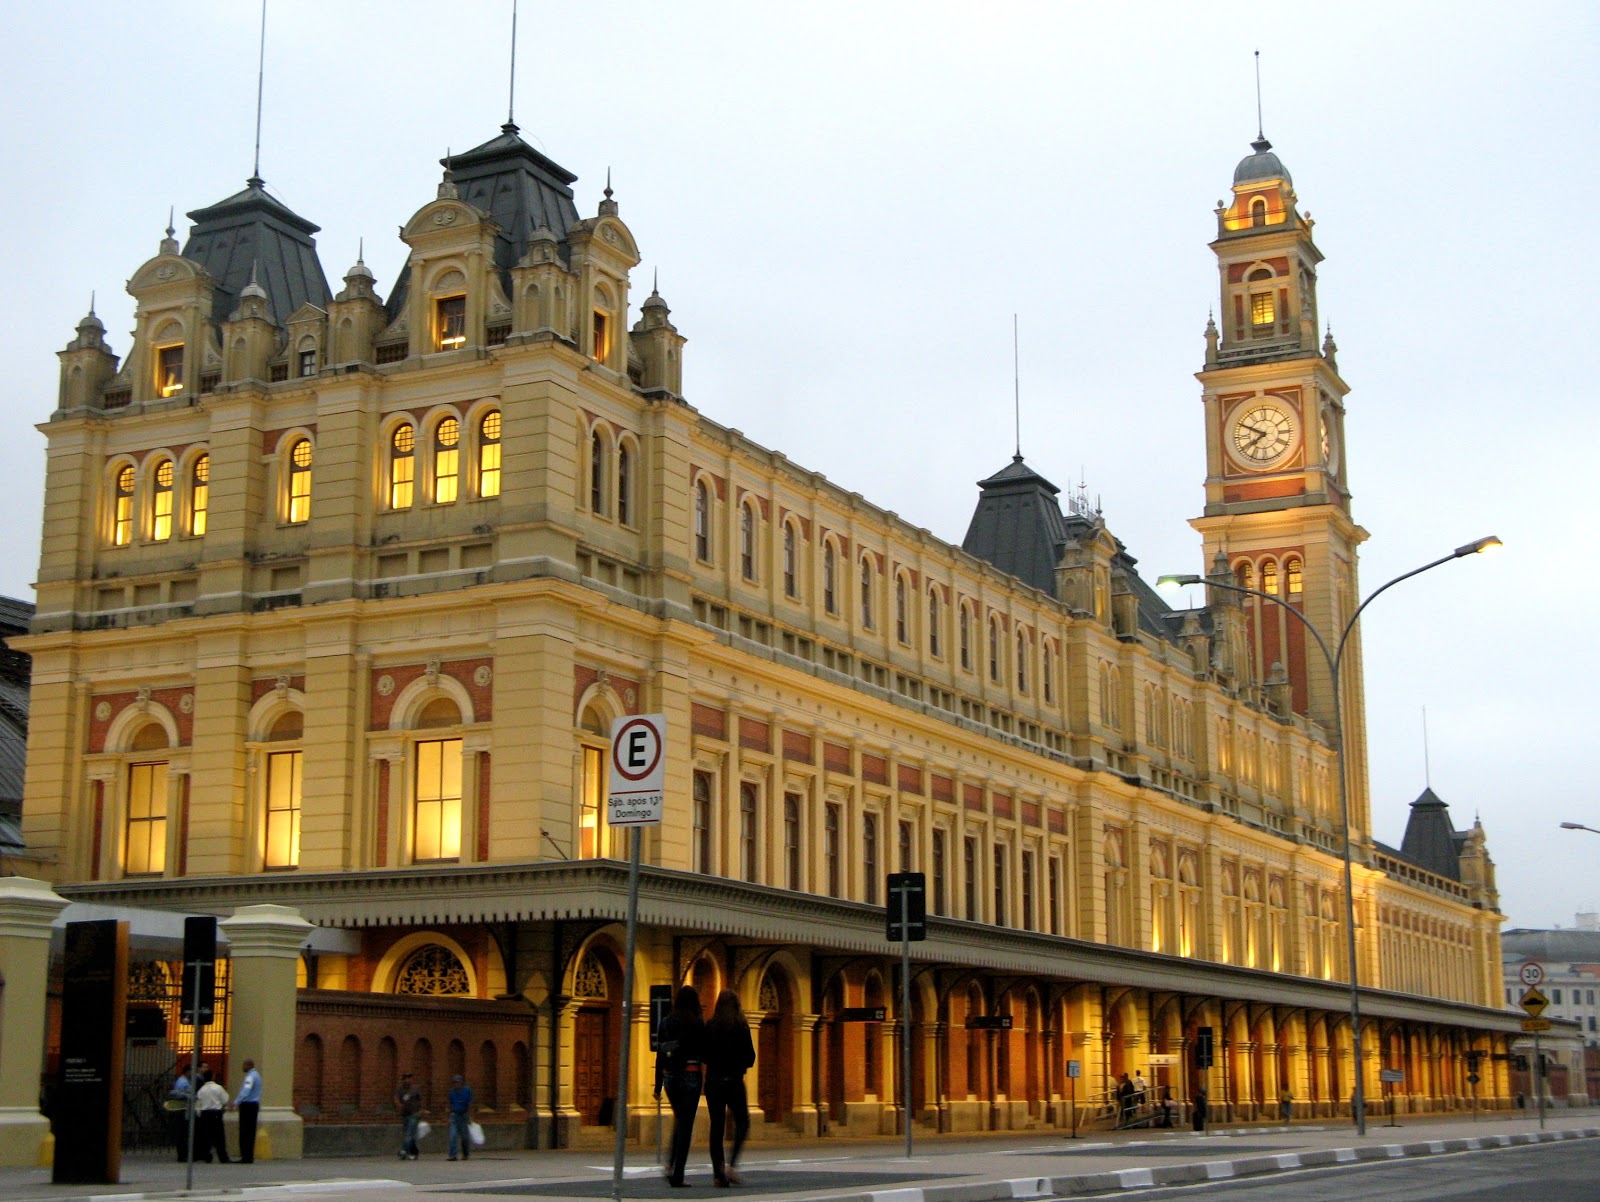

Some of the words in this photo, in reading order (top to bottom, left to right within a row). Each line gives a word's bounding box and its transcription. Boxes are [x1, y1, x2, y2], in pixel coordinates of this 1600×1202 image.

[629, 731, 646, 767] E
[616, 809, 651, 819] Domingo
[1525, 969, 1539, 978] 30
